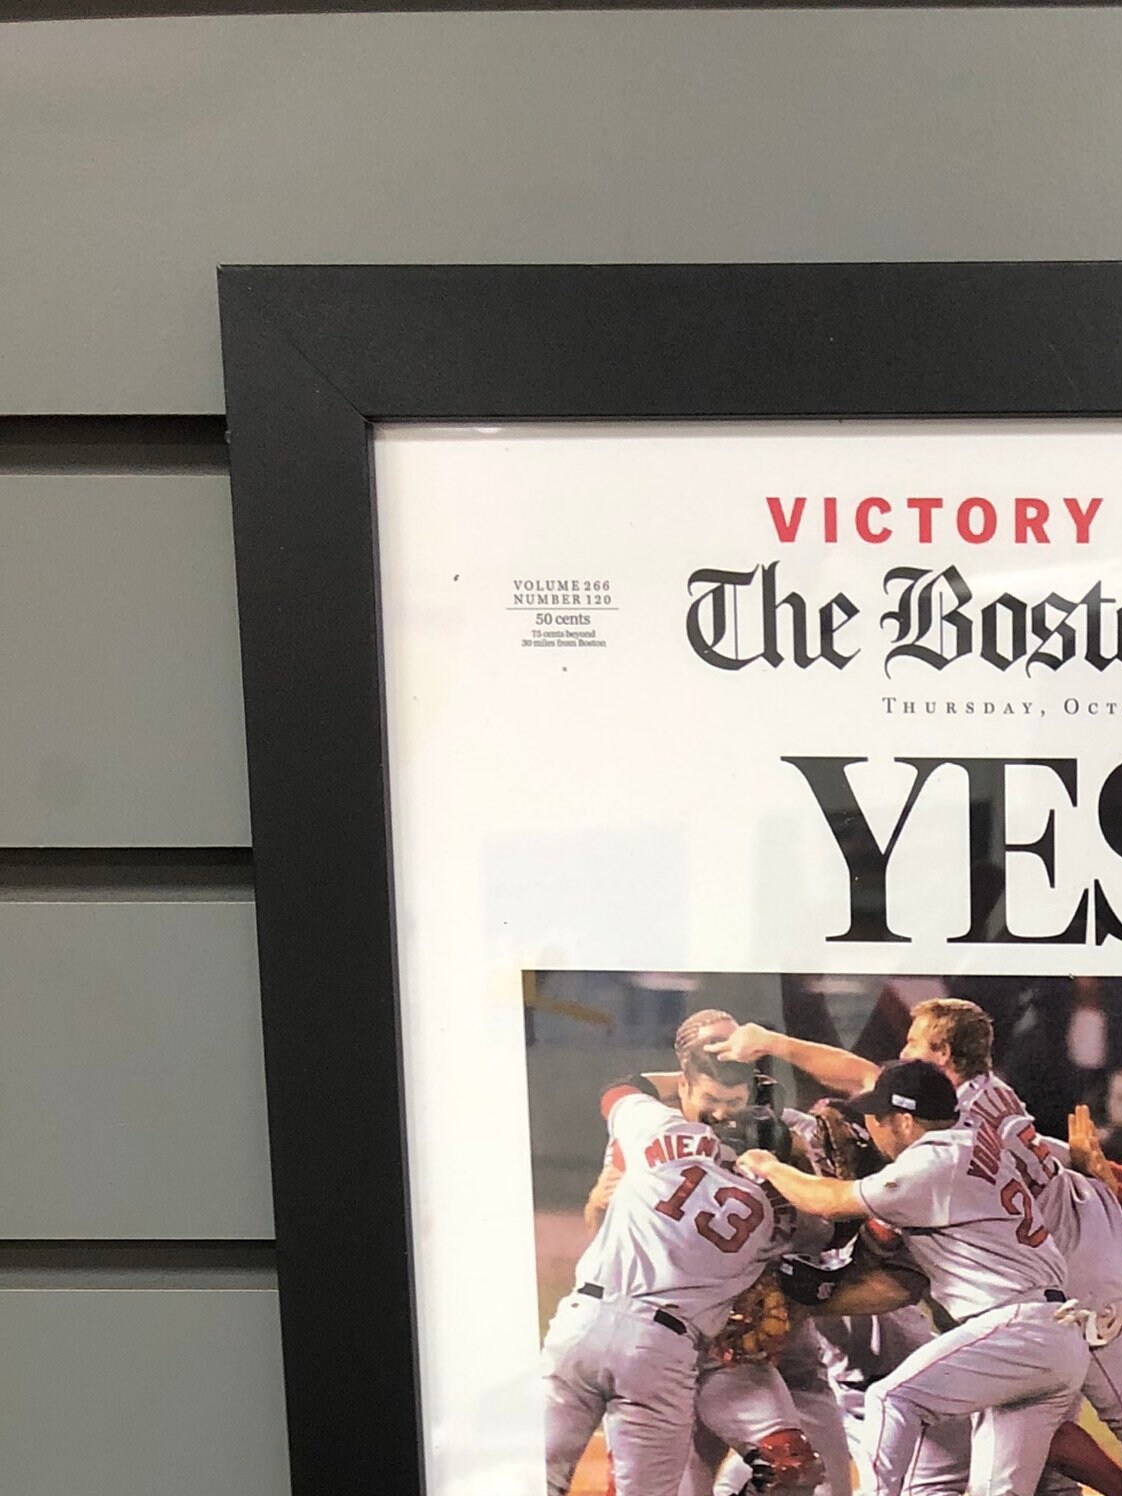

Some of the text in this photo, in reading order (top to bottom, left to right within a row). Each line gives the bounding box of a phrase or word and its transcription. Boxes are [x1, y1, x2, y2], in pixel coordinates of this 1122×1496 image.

[766, 497, 1102, 544] VICTORY
[513, 580, 609, 591] VOLUME 266
[514, 593, 610, 604] NUMBER 120
[536, 612, 590, 624] 50 cents
[686, 560, 860, 670] The
[655, 1165, 765, 1253] 13
